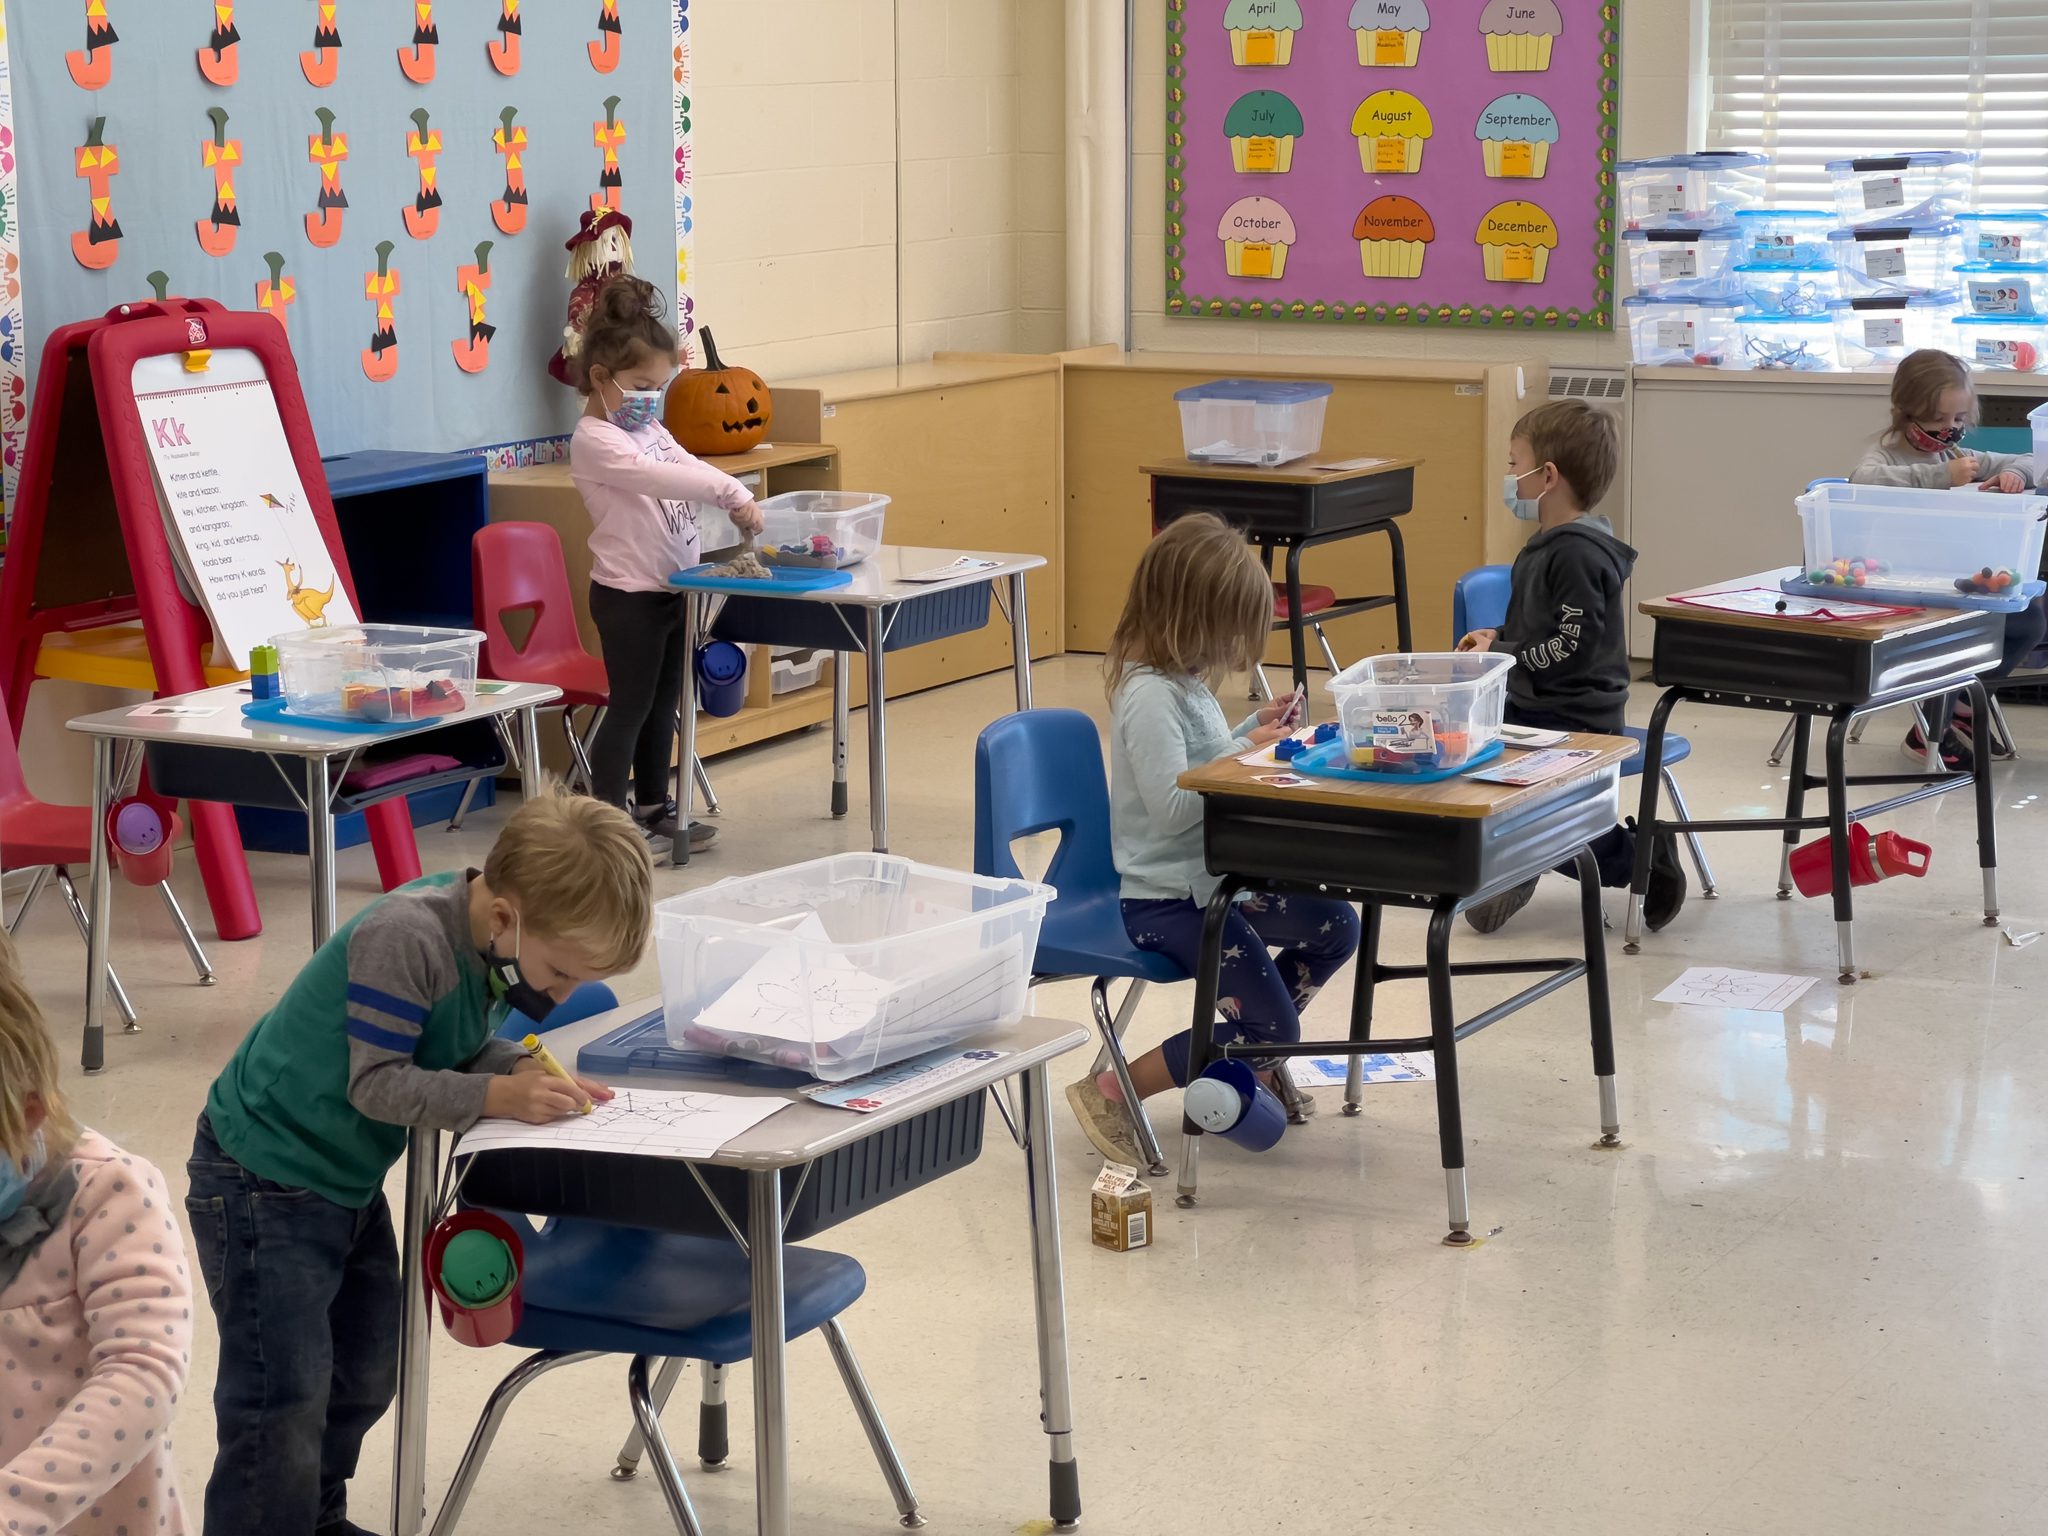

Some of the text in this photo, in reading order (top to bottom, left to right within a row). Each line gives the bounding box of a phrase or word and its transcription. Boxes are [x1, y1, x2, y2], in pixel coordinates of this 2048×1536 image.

[1248, 2, 1276, 17] April
[1377, 2, 1401, 17] May
[1506, 6, 1535, 19] June
[1251, 109, 1275, 124] July
[1372, 110, 1412, 124] August
[1485, 112, 1551, 128] September
[1233, 216, 1281, 229] October
[1364, 215, 1424, 227] November
[1488, 219, 1547, 233] December
[152, 417, 191, 449] Kk
[488, 450, 515, 469] each
[189, 471, 200, 480] and
[189, 489, 200, 498] and
[189, 525, 201, 534] and
[223, 537, 235, 546] and
[208, 575, 223, 584] How
[224, 572, 241, 581] many
[241, 571, 247, 579] K
[216, 592, 226, 601] did
[228, 591, 239, 600] you
